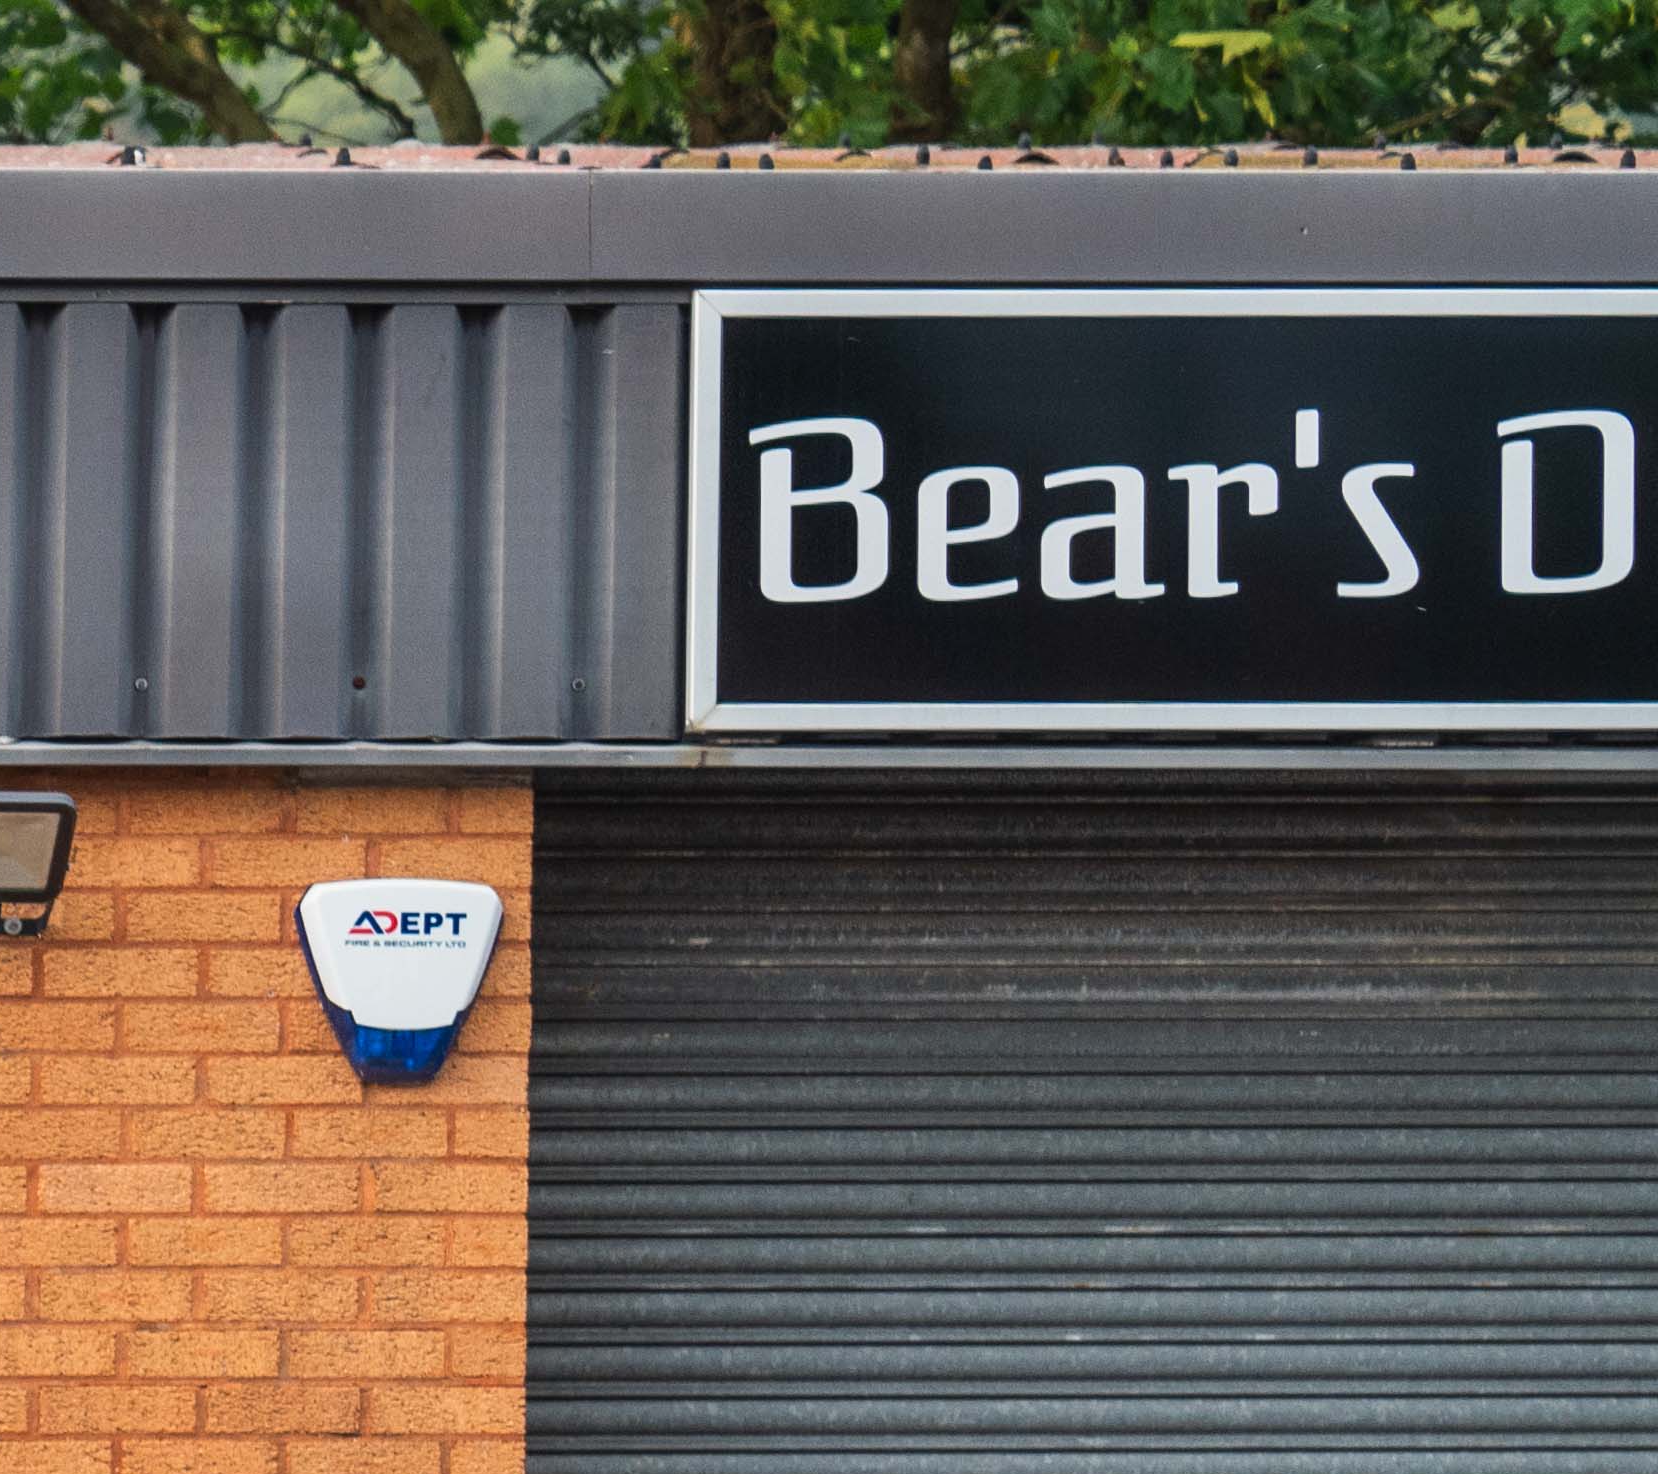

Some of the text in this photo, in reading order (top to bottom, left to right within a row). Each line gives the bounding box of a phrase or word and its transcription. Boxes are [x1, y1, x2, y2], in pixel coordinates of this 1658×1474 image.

[748, 408, 1420, 603] Bear's
[348, 910, 468, 936] ADEPT
[344, 938, 467, 949] FIRE & SECURITY LTD
